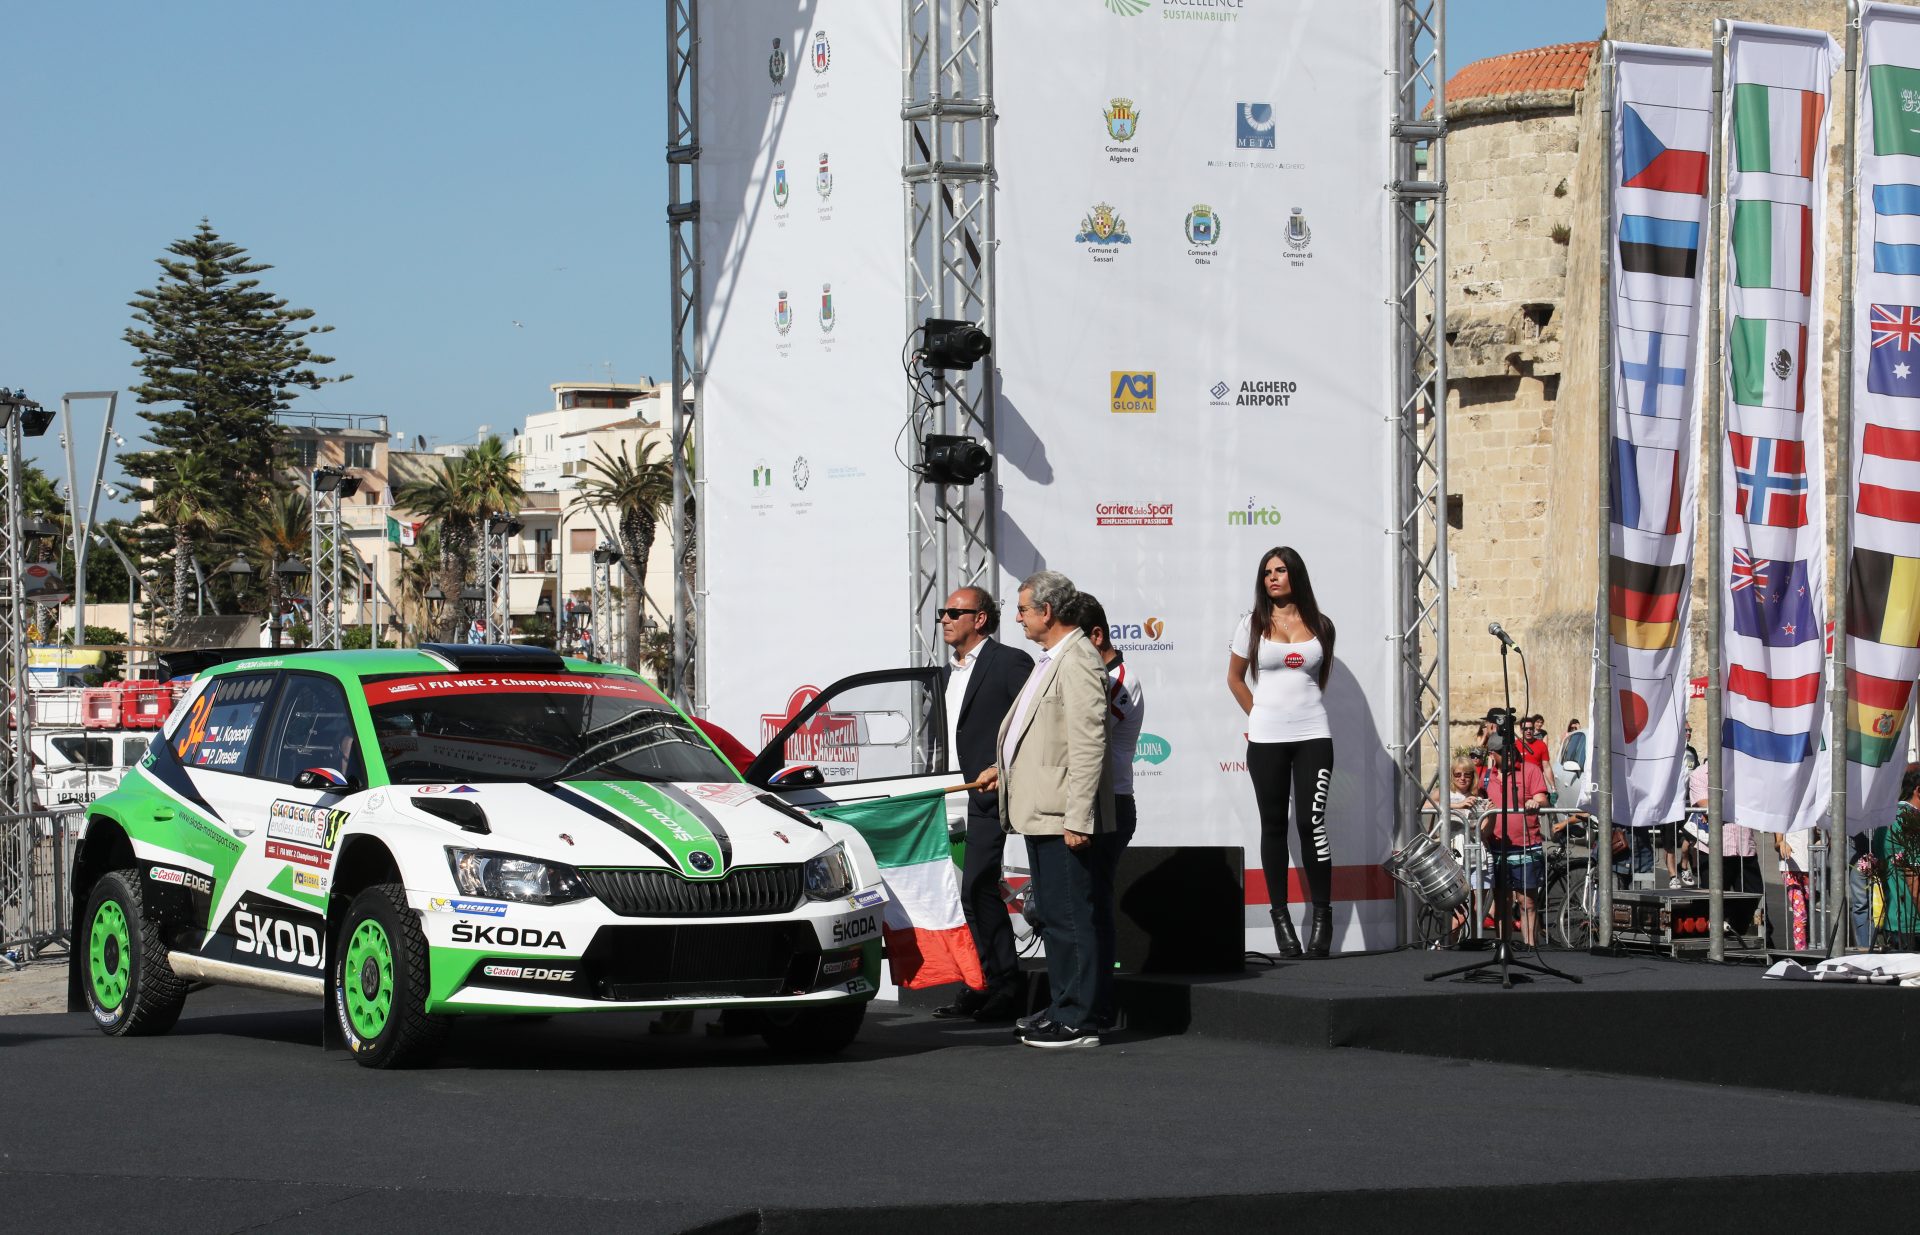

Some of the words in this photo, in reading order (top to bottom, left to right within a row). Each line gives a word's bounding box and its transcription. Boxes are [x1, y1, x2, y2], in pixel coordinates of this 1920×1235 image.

[1163, 9, 1238, 22] SUSTAINABILITY
[1105, 145, 1131, 153] Comune
[1238, 138, 1274, 148] META
[1109, 155, 1135, 164] Alghero
[1093, 255, 1114, 263] Sassari
[1187, 249, 1210, 257] Comune
[1113, 374, 1154, 399] ACI
[1240, 380, 1297, 393] ALGHERO
[1113, 401, 1154, 411] GLOBAL
[1235, 394, 1290, 406] AIRPORT
[1096, 503, 1134, 515] Corriere
[1147, 503, 1173, 518] Sport
[1227, 504, 1282, 526] mirtò
[1110, 622, 1142, 639] ara
[1118, 641, 1174, 651] assicurazioni
[429, 680, 454, 689] FIA
[454, 679, 487, 687] WRC
[488, 678, 500, 686] 2
[501, 678, 593, 690] Championship
[179, 692, 216, 757] 34
[1135, 742, 1163, 756] ALDINA
[271, 803, 316, 825] SARDEGNA
[315, 811, 326, 840] 2017
[157, 867, 183, 886] Castrol
[183, 872, 213, 895] EDGE
[455, 901, 508, 914] MICHELIN
[233, 901, 326, 970] ŠKOD
[451, 919, 567, 950] ŠKODA
[833, 915, 877, 943] ŠKODA
[492, 966, 520, 978] Castrol
[520, 967, 577, 982] EDGE
